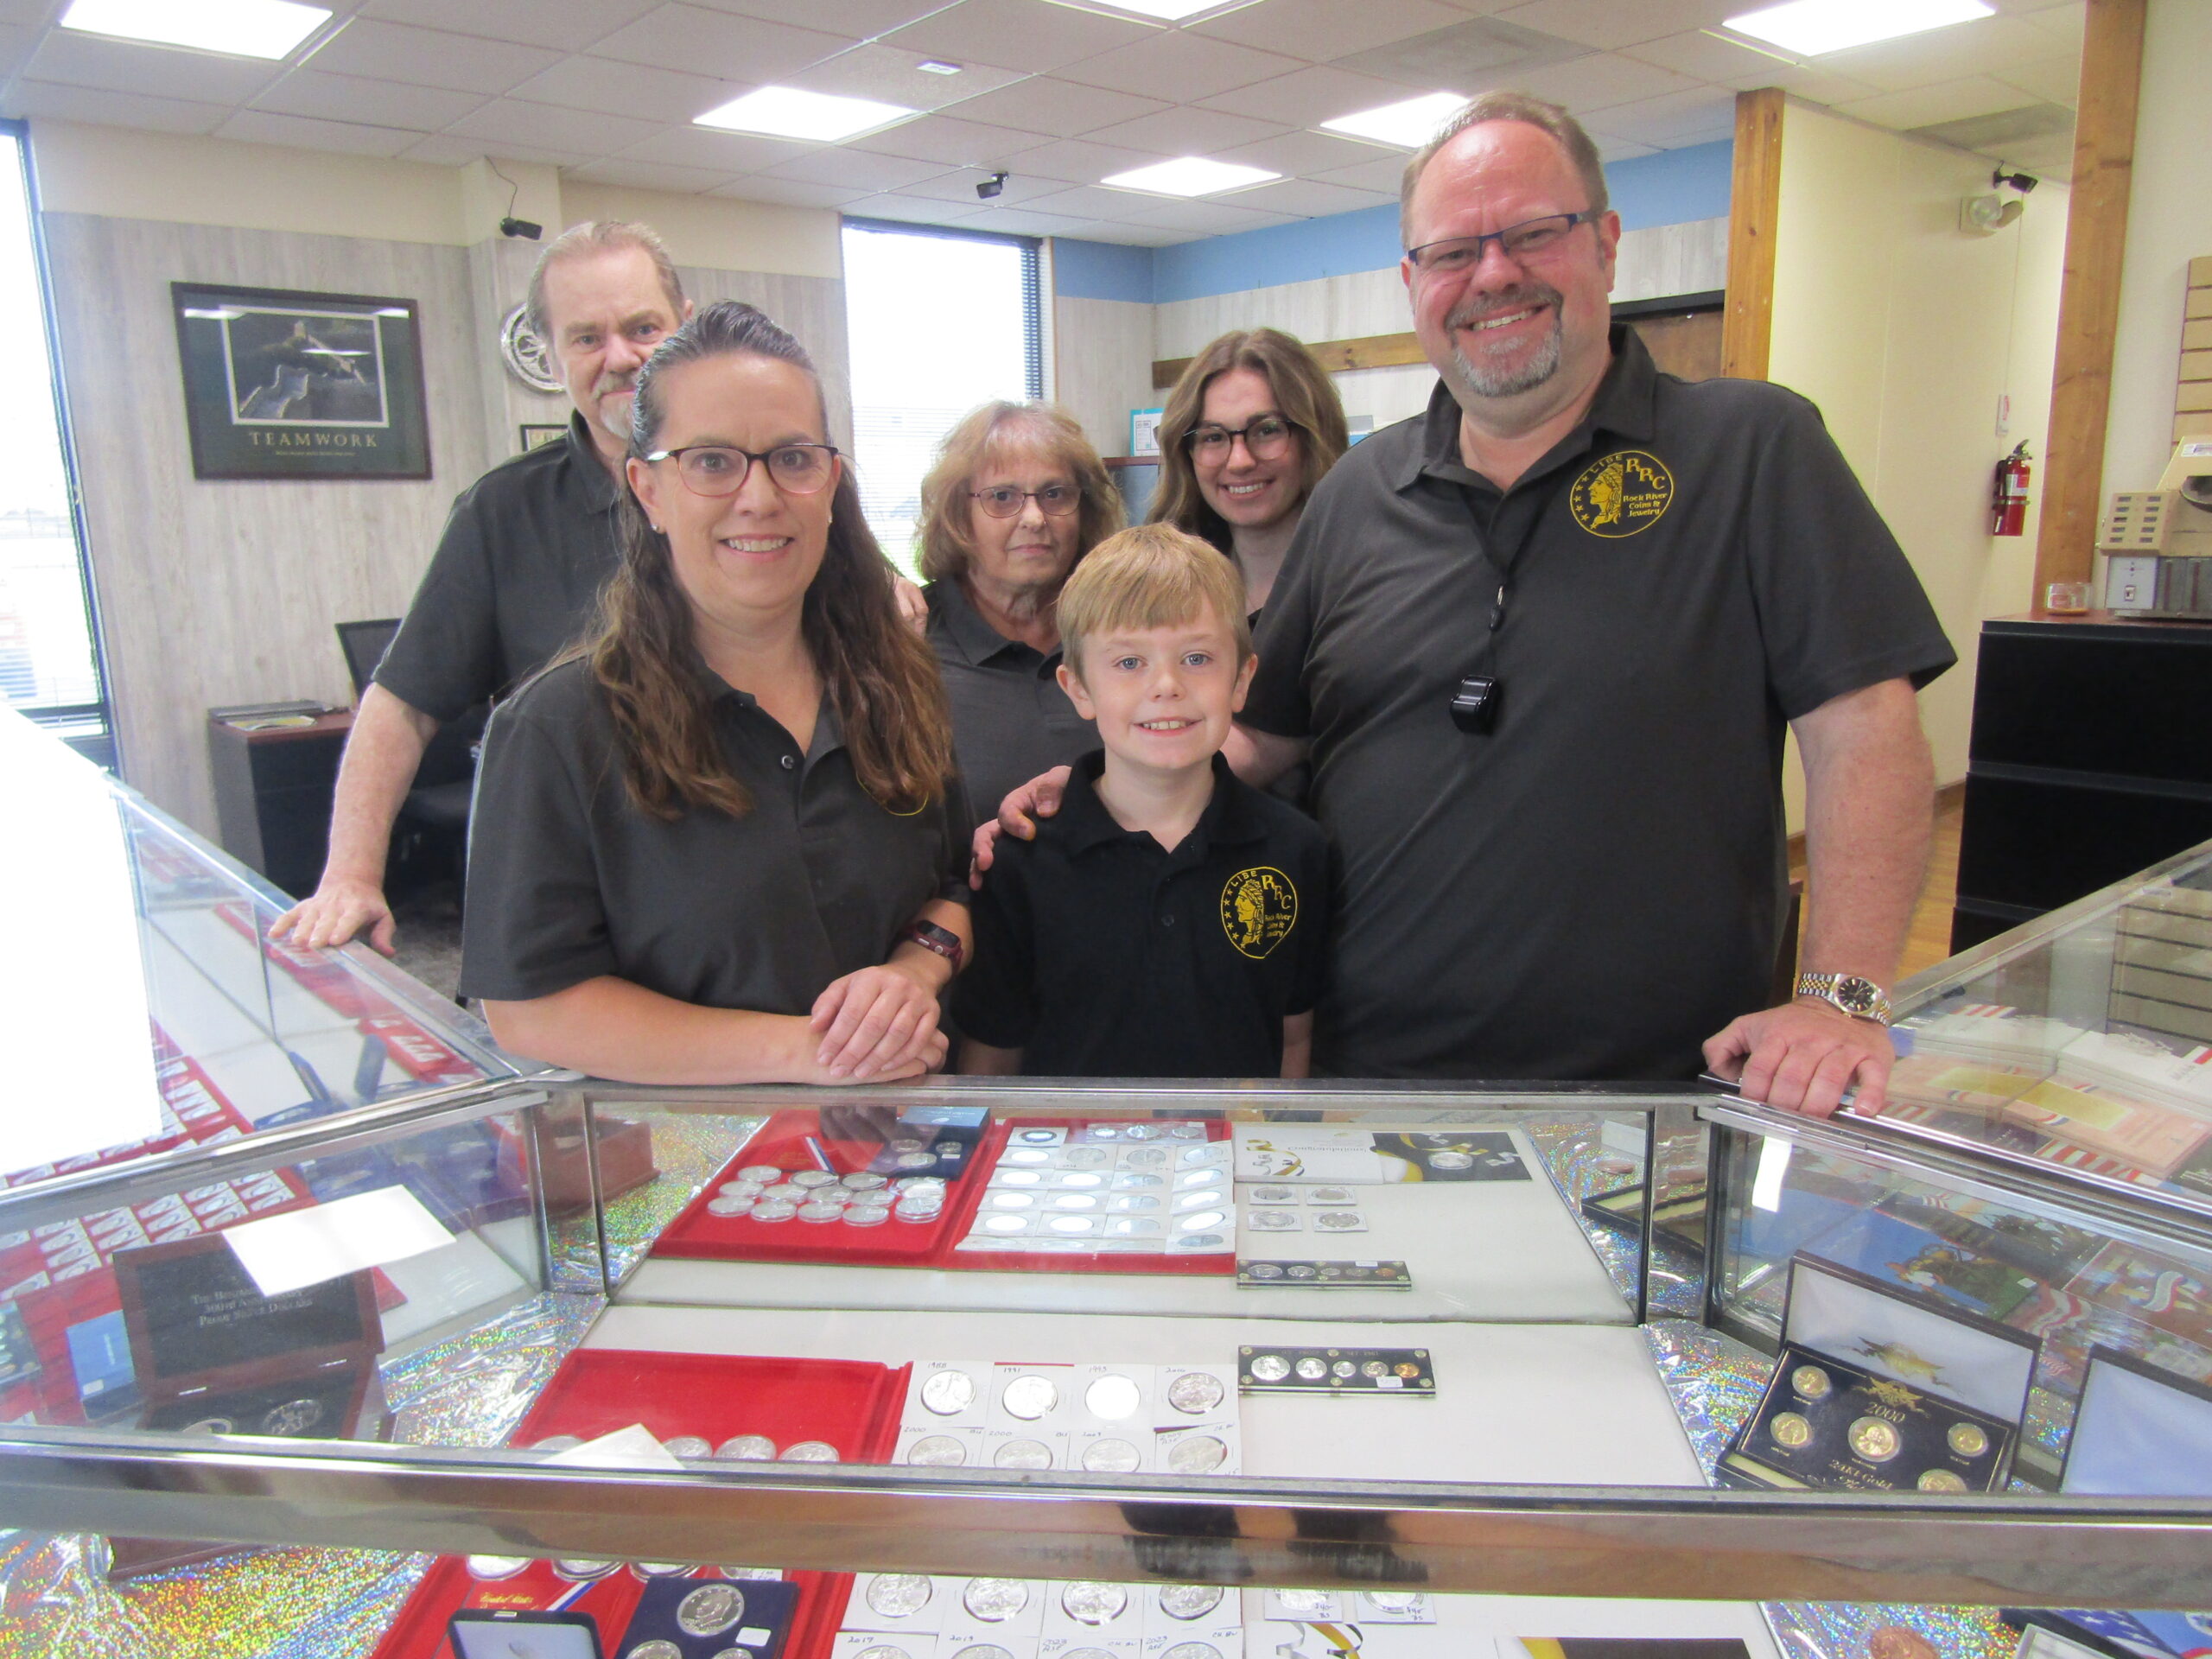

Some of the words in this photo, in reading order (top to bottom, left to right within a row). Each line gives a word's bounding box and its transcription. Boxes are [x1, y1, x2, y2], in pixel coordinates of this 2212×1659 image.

[248, 432, 378, 448] TEAMWORK
[1645, 493, 1668, 501] River
[1628, 501, 1652, 510] Coins
[1652, 499, 1661, 508] &
[1626, 508, 1661, 518] Jewelry
[1230, 870, 1258, 887] LIBE
[1863, 1401, 1907, 1425] 2000
